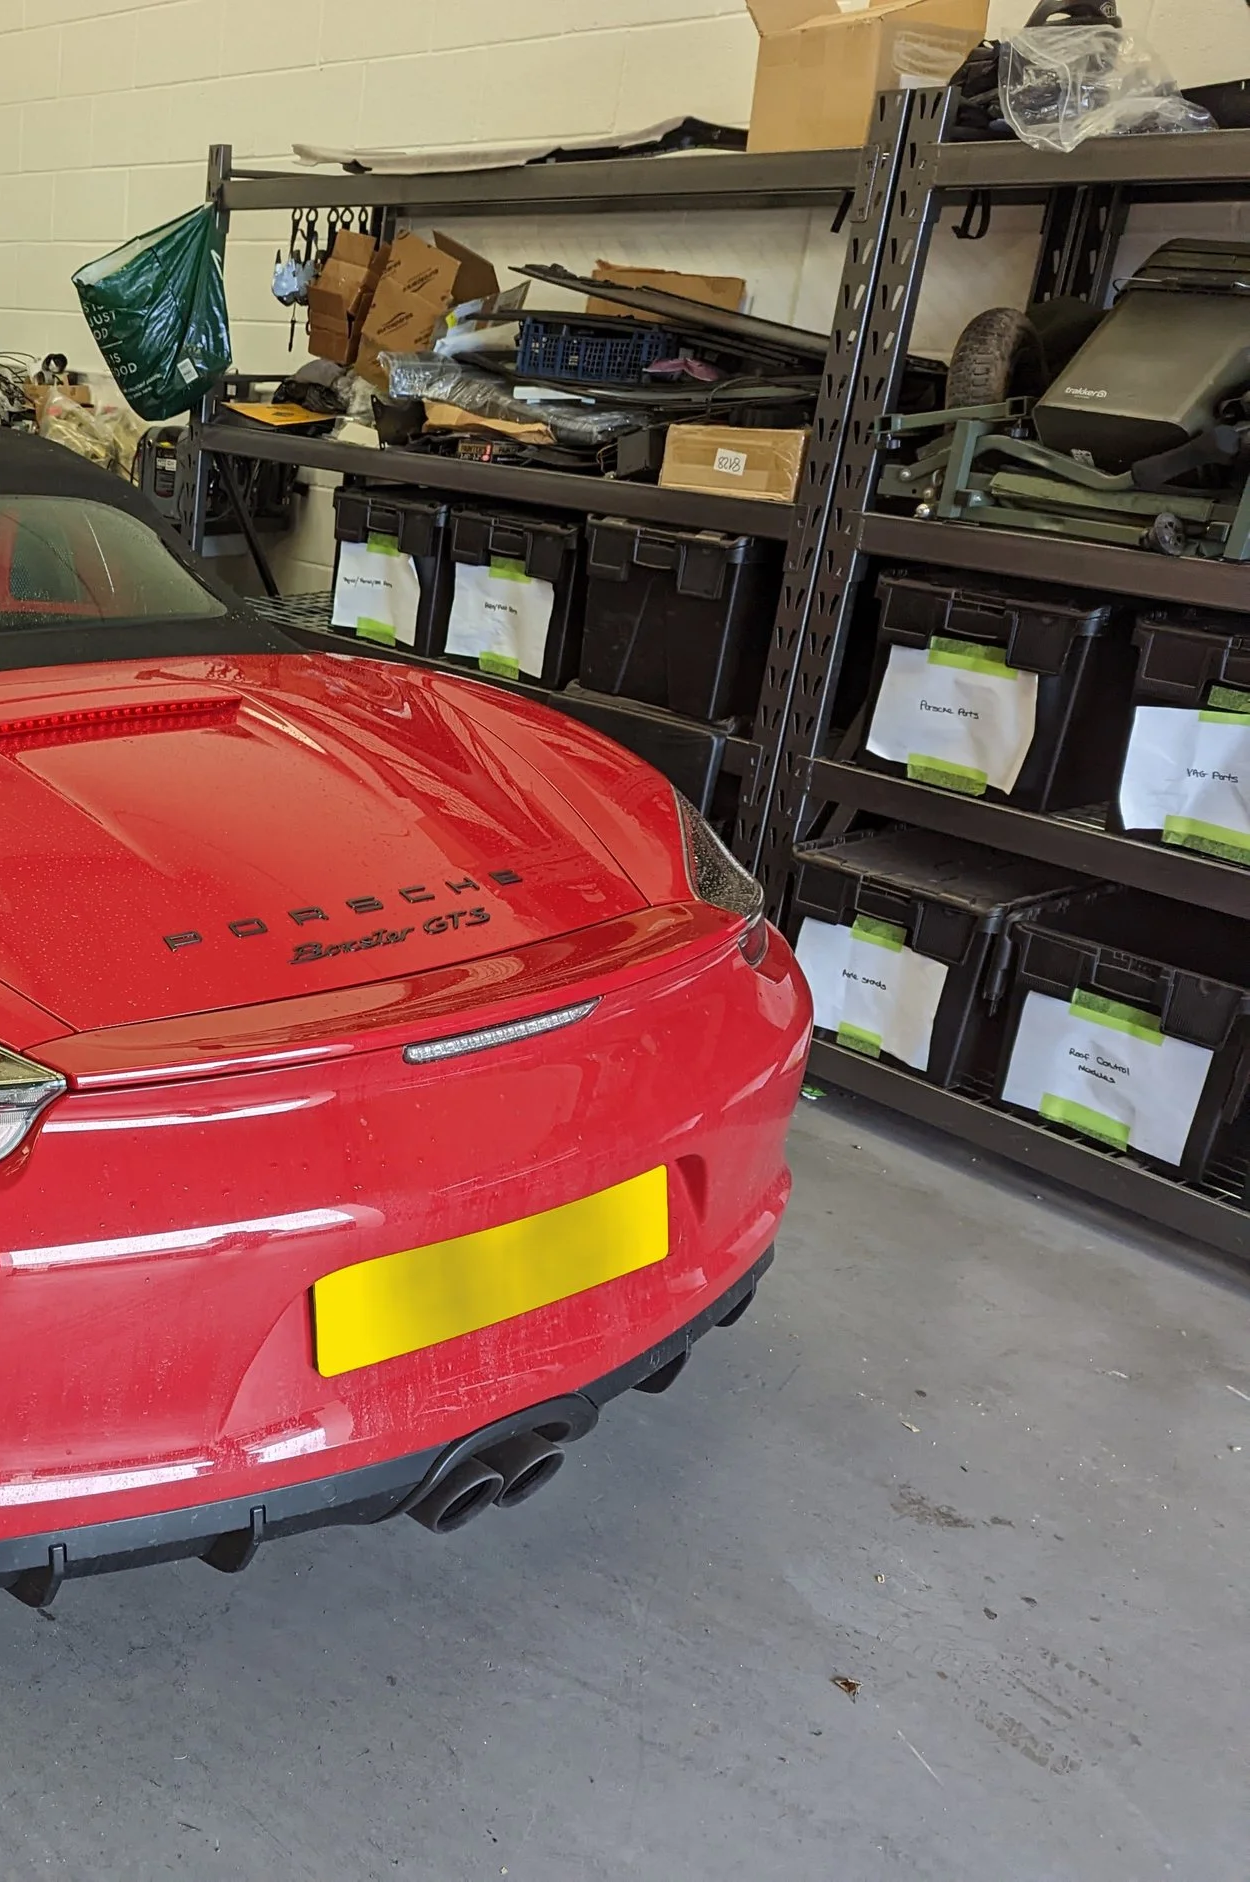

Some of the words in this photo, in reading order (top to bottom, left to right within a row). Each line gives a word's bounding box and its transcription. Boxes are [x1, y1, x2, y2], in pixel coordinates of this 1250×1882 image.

[920, 699, 954, 715] Porsche
[957, 707, 980, 720] Parts
[1186, 767, 1209, 778] VAG
[1211, 771, 1239, 783] Parts
[162, 868, 524, 953] PORSCHE
[288, 926, 415, 965] Boxster
[423, 906, 491, 935] GTS
[1068, 1047, 1090, 1061] Roof
[1096, 1056, 1130, 1076] Control
